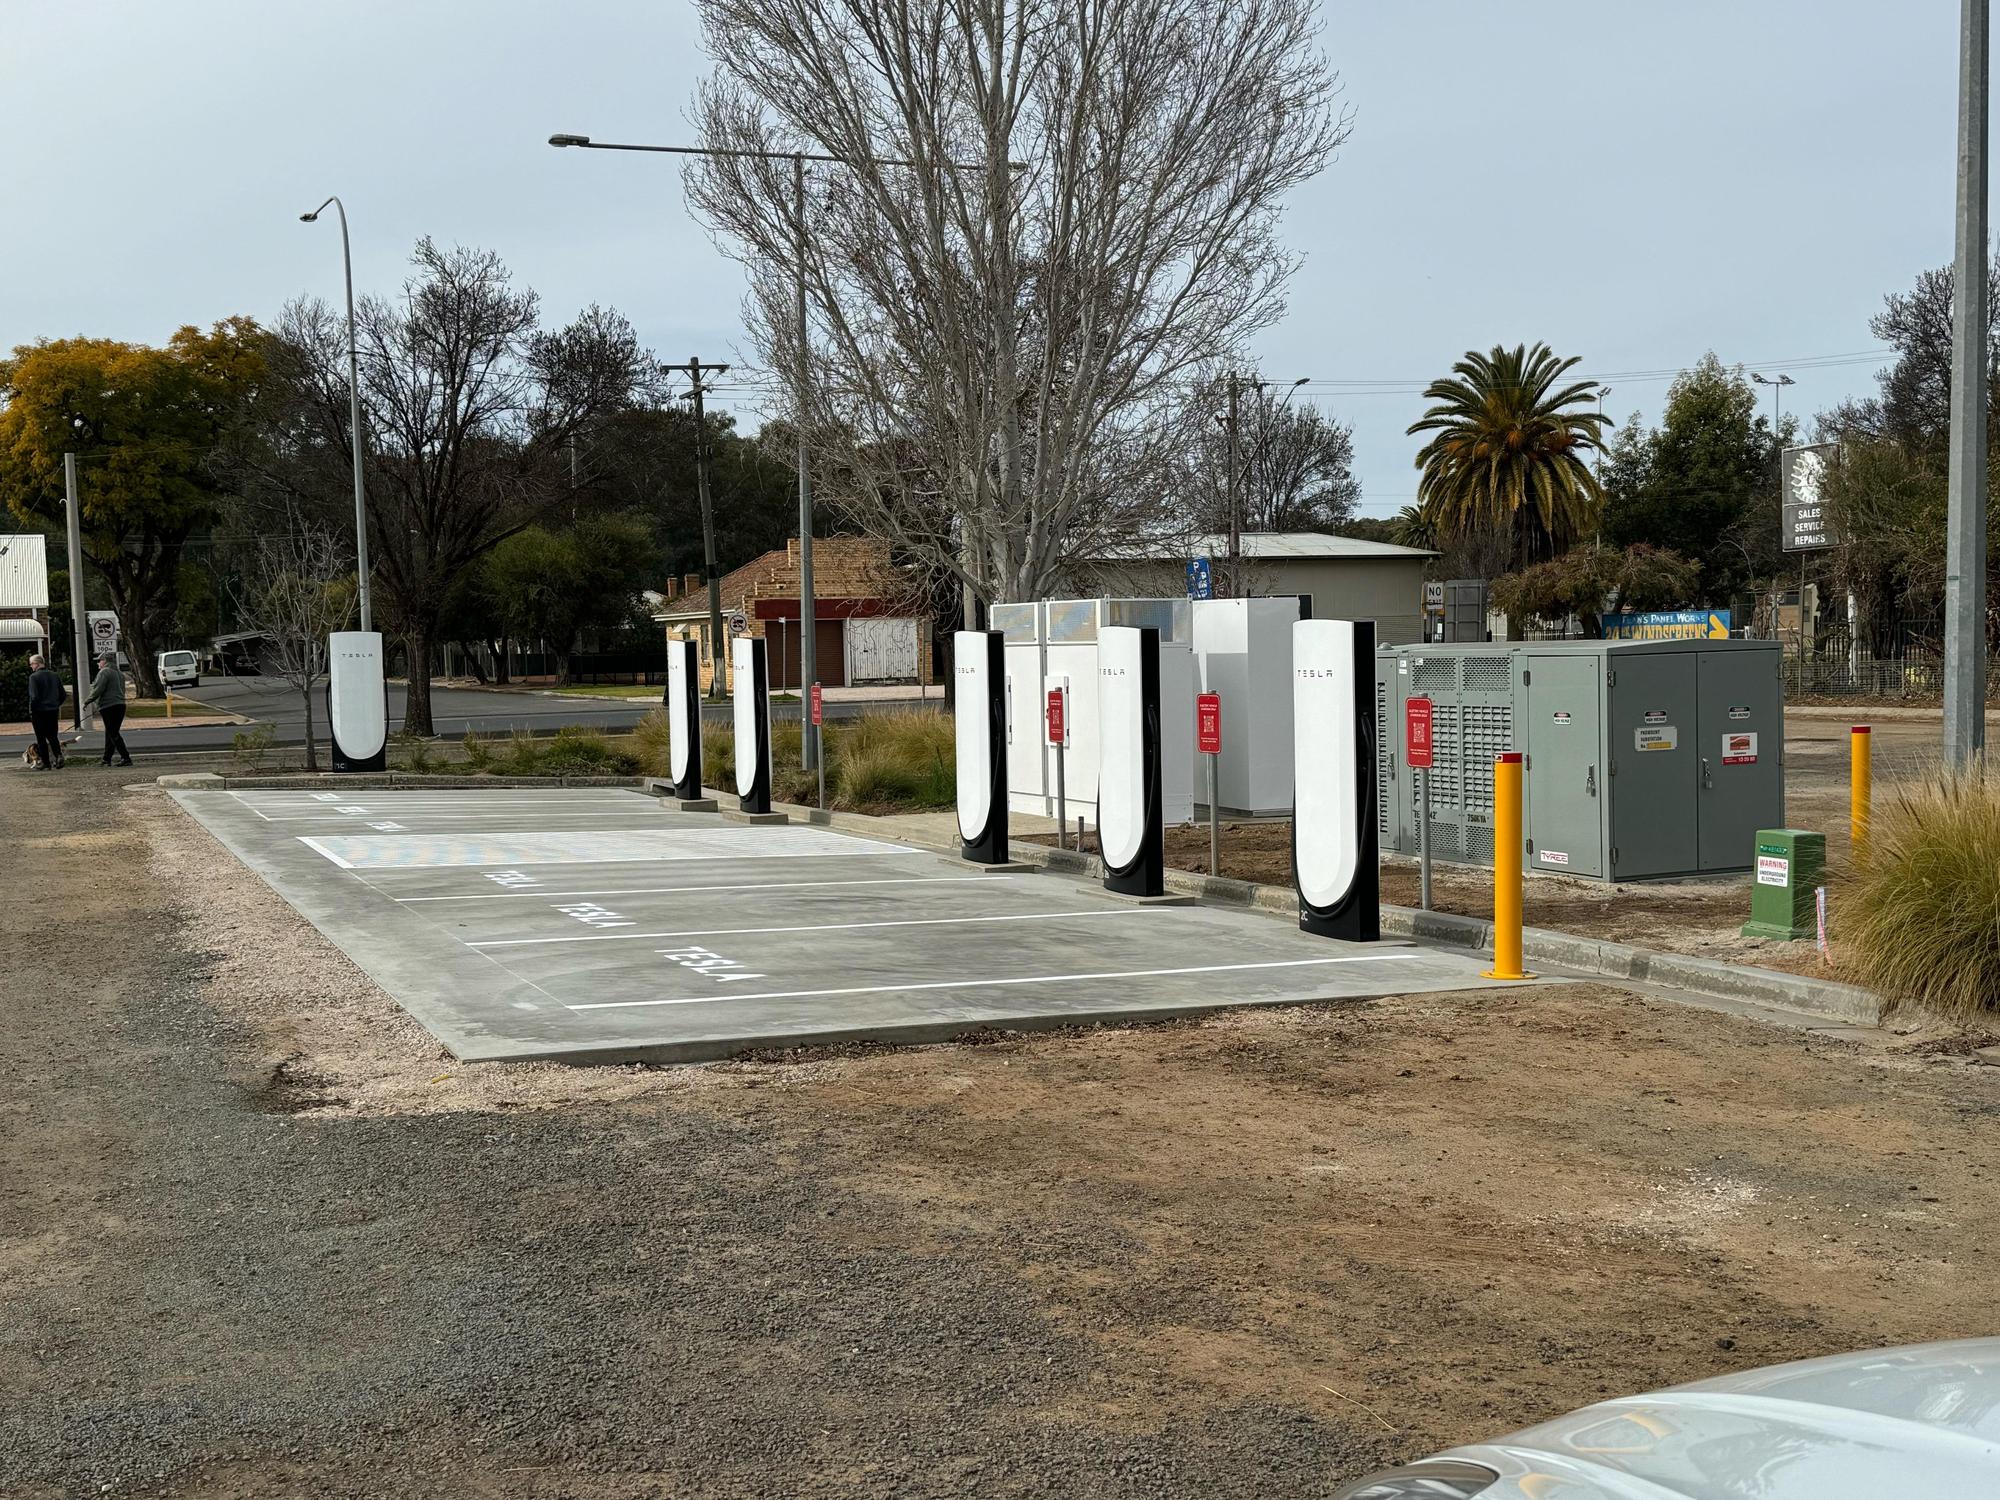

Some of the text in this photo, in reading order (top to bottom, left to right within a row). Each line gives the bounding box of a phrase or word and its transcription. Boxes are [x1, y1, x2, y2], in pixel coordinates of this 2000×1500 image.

[1798, 508, 1821, 519] SALES
[1428, 586, 1441, 596] NO
[1297, 669, 1333, 678] TESLA
[1759, 859, 1787, 869] WARNING
[550, 902, 638, 929] TESLA
[654, 946, 768, 982] TESLA
